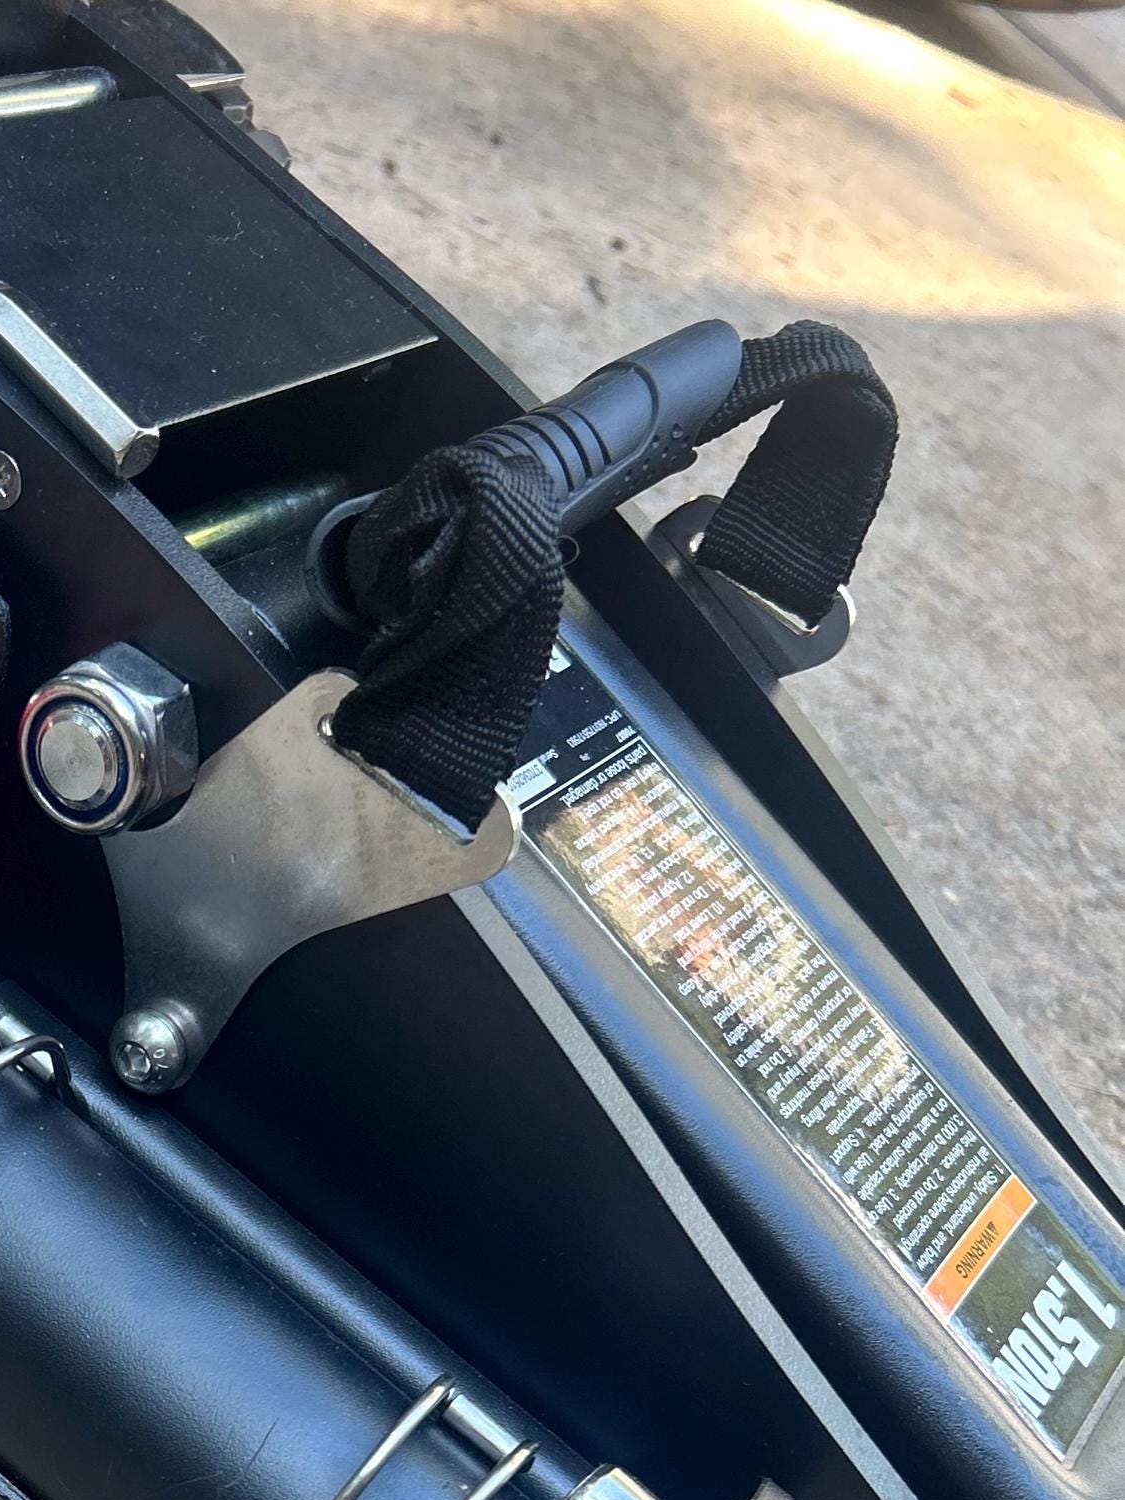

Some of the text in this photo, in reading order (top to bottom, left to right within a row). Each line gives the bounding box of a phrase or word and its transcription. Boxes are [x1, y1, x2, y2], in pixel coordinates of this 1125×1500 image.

[603, 709, 623, 724] UPC
[558, 744, 648, 807] parts loose or damaged.
[635, 762, 662, 781] every
[596, 793, 614, 810] not
[609, 787, 626, 799] do
[582, 802, 601, 817] use
[572, 828, 602, 849] before
[637, 844, 655, 859] 13.
[656, 851, 682, 874] chock
[640, 866, 663, 883] tires
[678, 869, 696, 884] 12.
[703, 877, 720, 892] 11.
[582, 878, 604, 895] only
[656, 877, 685, 898] Apply
[691, 886, 709, 900] Do
[672, 873, 759, 945] lowering. 10. Lower load
[679, 894, 696, 911] not
[741, 903, 754, 917] of
[749, 890, 771, 909] clear
[655, 913, 673, 927] for
[666, 903, 685, 919] use
[726, 909, 748, 930] load
[632, 921, 661, 948] aircraf
[708, 922, 731, 942] while
[741, 916, 768, 942] gloves
[676, 951, 695, 970] and
[746, 935, 777, 965] goggles
[809, 953, 828, 968] the
[675, 975, 704, 996] Keep
[774, 986, 791, 1000] Do
[763, 994, 779, 1012] not
[733, 969, 839, 1067] move or dolly the vehicle while on
[743, 1004, 768, 1030] adjust
[721, 1022, 748, 1046] safety
[756, 985, 853, 1078] or property damage. 6. Do not
[764, 1001, 866, 1102] may result in personal injury and/
[868, 1033, 895, 1059] eans
[778, 1016, 882, 1118] 5. Failure to heed these markings
[830, 1054, 875, 1095] immediately
[871, 1062, 896, 1087] ehicle
[890, 1062, 921, 1100] provided
[922, 1081, 934, 1096] of
[817, 1089, 837, 1110] after
[878, 1092, 895, 1113] skid
[890, 1088, 927, 1126] supporting
[799, 1104, 825, 1126] lifting.
[824, 1095, 863, 1135] appropriate
[861, 1103, 883, 1127] plate.
[854, 1125, 867, 1138] 4.
[882, 1121, 900, 1138] the
[940, 1113, 963, 1139] 3,000
[829, 1133, 860, 1166] Support
[856, 1097, 948, 1200] on a hard, level surface capable
[868, 1132, 890, 1155] load.
[934, 1132, 947, 1147] lb
[853, 1151, 873, 1170] Use
[919, 1139, 939, 1164] rated
[841, 1164, 859, 1186] with
[892, 1129, 977, 1230] this device. 2. Do not exceed
[893, 1157, 924, 1189] capacity.
[874, 1195, 893, 1214] Use
[886, 1187, 900, 1201] 3.
[900, 1145, 989, 1250] all instructions before operating
[914, 1161, 1004, 1270] 1. Study, understand, and follow
[954, 1227, 995, 1280] WARNING
